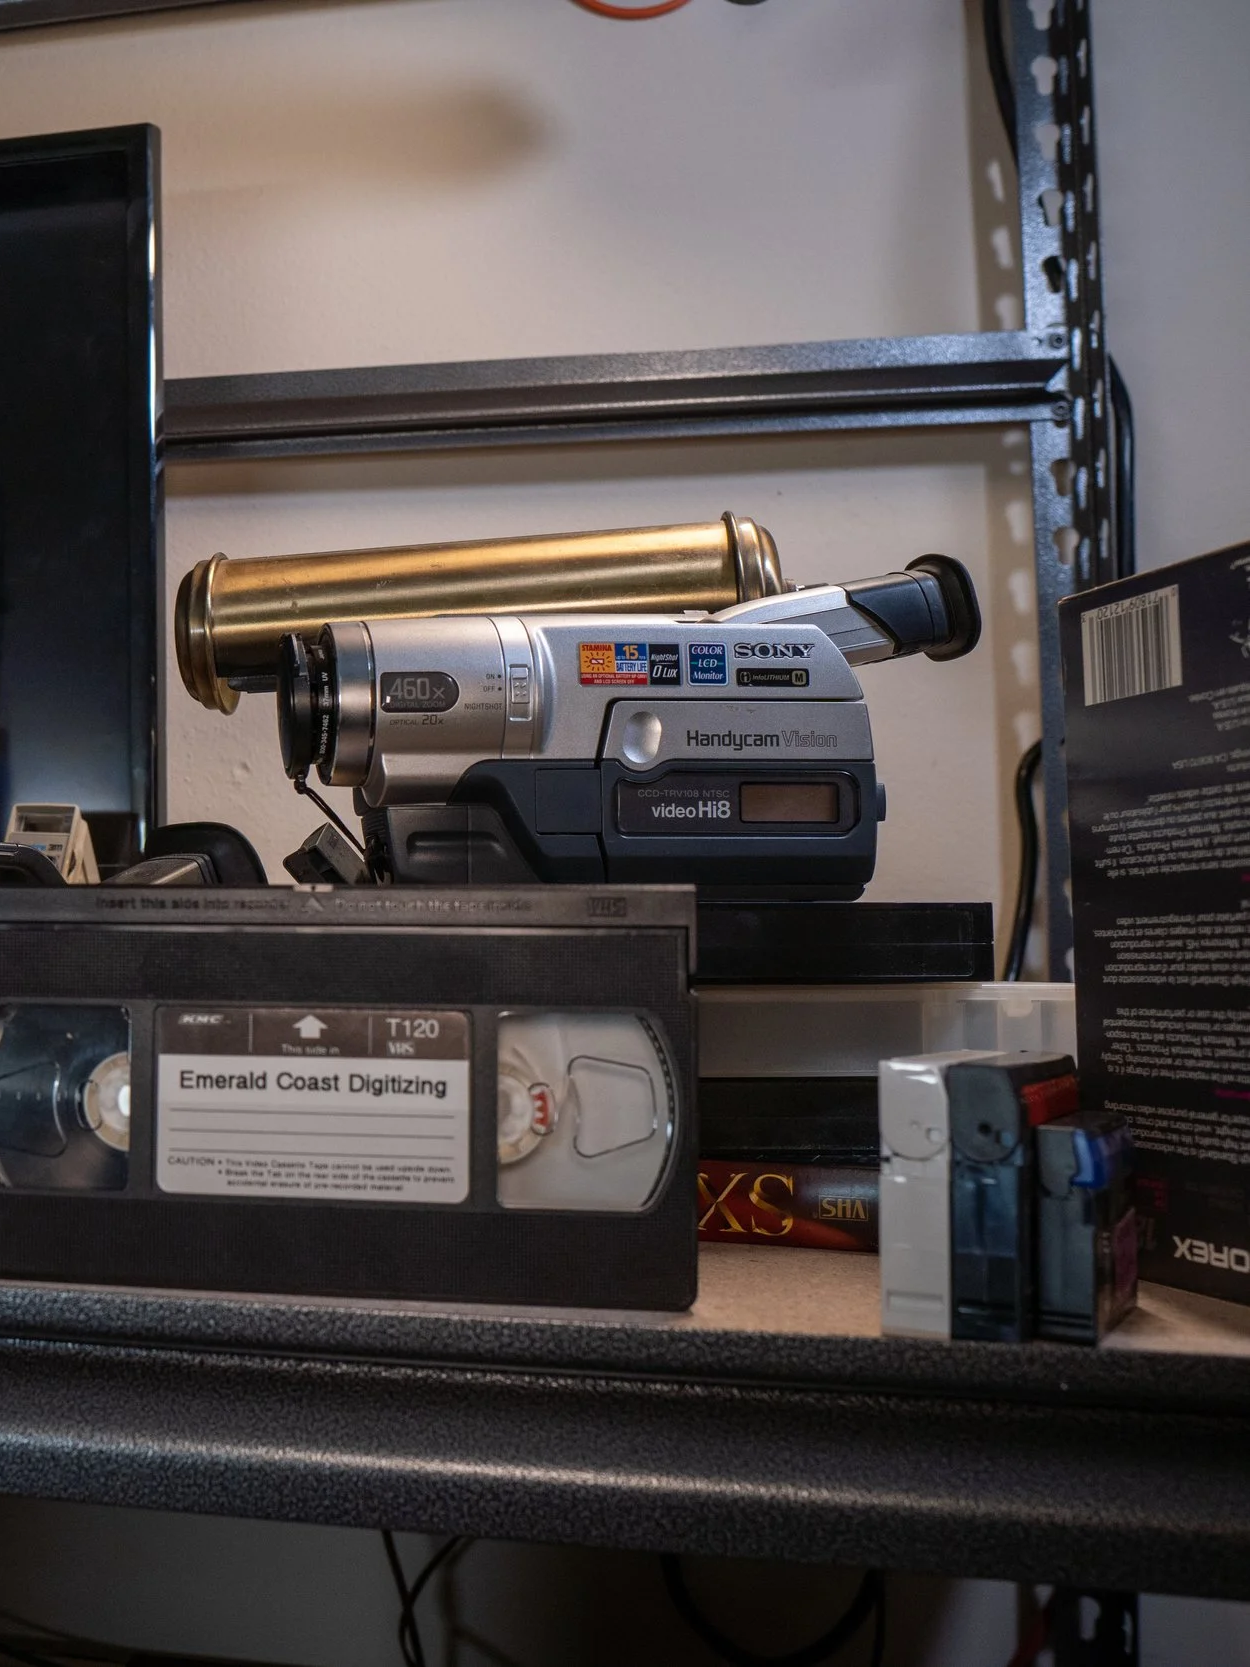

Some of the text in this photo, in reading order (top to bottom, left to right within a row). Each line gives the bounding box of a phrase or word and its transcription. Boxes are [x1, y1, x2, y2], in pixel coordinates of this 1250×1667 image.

[582, 644, 612, 652] STAMINA
[623, 645, 638, 660] 15
[691, 646, 723, 655] COLOR
[734, 642, 815, 659] SONY
[616, 662, 647, 672] BATTERY LIFE
[698, 659, 717, 668] LCD
[322, 671, 328, 682] UV
[693, 670, 723, 680] Monitor
[464, 703, 502, 711] NIGHTSHOT
[687, 731, 838, 750] Handycam Vision
[638, 789, 730, 798] CCD-TRV108 NTSC
[651, 800, 730, 818] video Hi8
[141, 897, 166, 910] this
[386, 1017, 440, 1039] T120
[282, 1043, 302, 1054] This
[305, 1044, 327, 1055] side
[179, 1071, 448, 1099] Emerald Coast Digitizing
[168, 1156, 215, 1166] CAUTION
